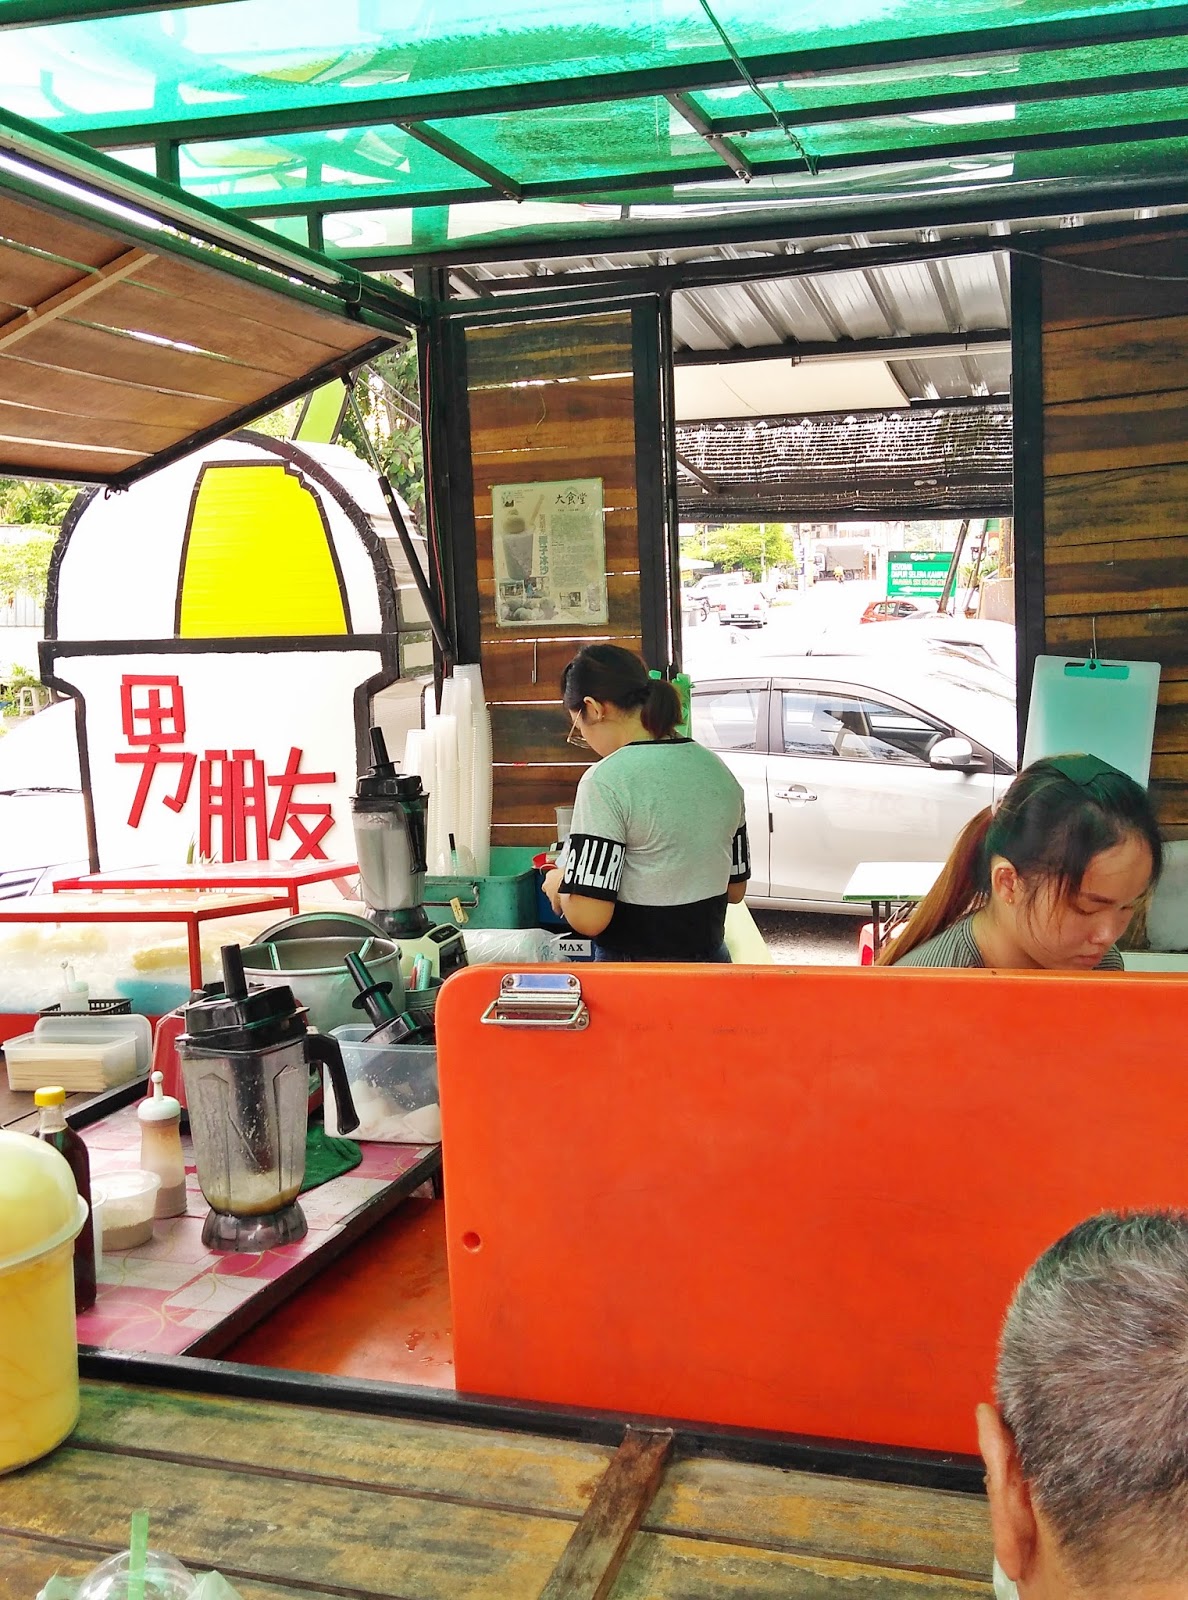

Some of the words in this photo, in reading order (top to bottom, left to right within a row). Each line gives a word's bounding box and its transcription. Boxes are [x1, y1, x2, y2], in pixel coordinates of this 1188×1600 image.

[114, 674, 336, 863] 男朋友
[559, 943, 584, 952] MAX
